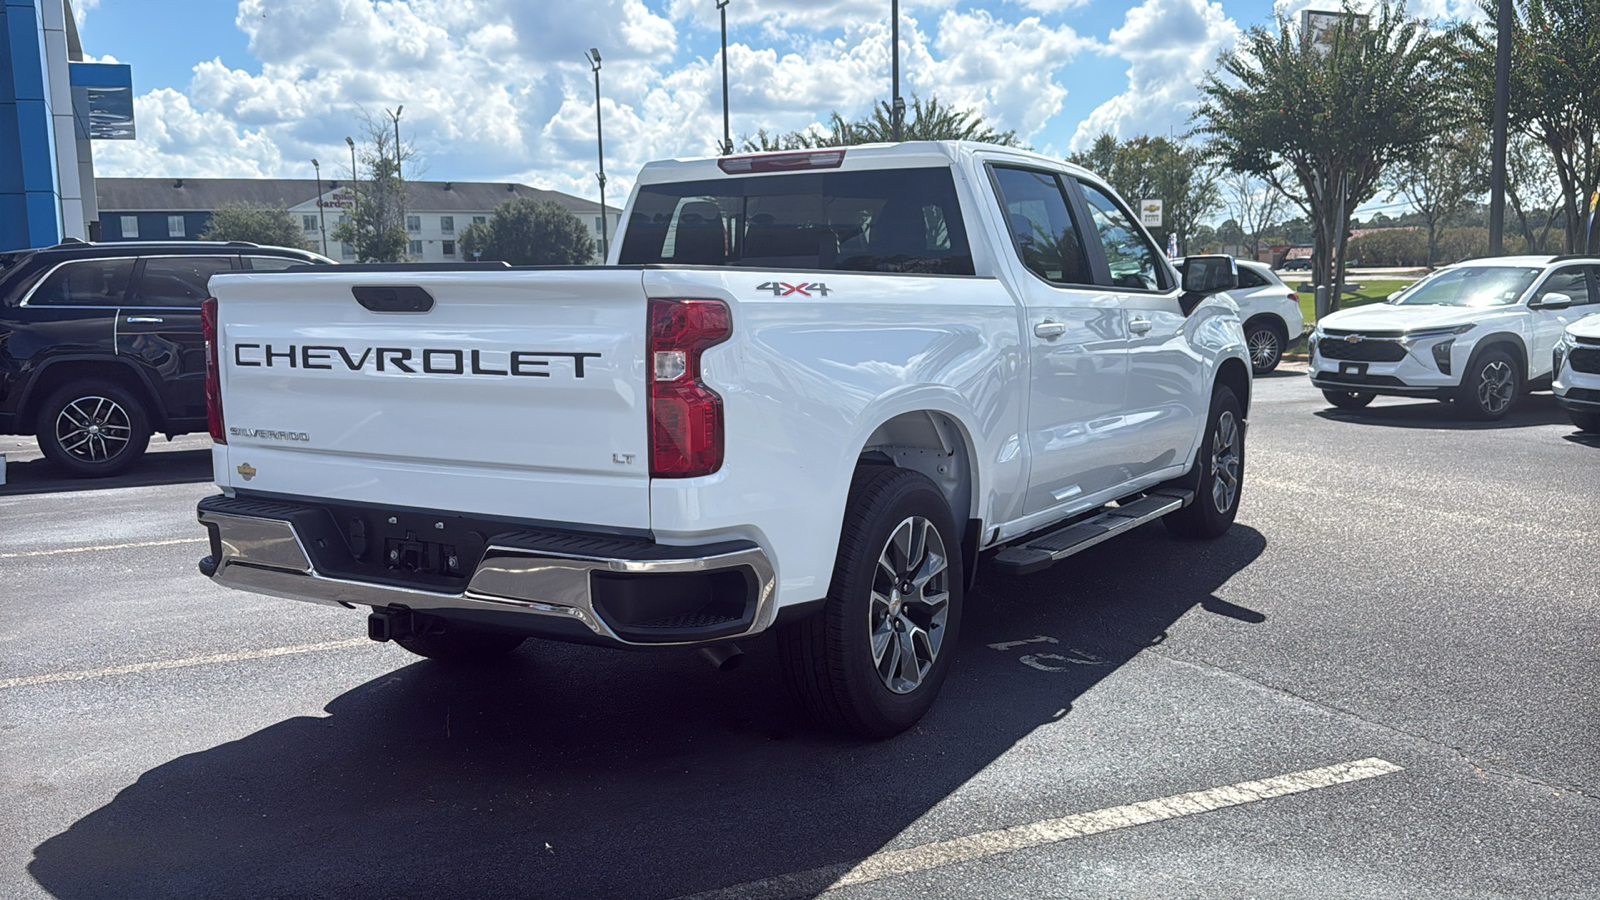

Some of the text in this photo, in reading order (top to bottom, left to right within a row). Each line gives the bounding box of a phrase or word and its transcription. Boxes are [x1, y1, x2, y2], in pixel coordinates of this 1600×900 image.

[756, 282, 833, 297] 4X4
[235, 343, 601, 378] CHEVROLET
[230, 427, 309, 441] SILVERADO
[612, 453, 636, 465] LT
